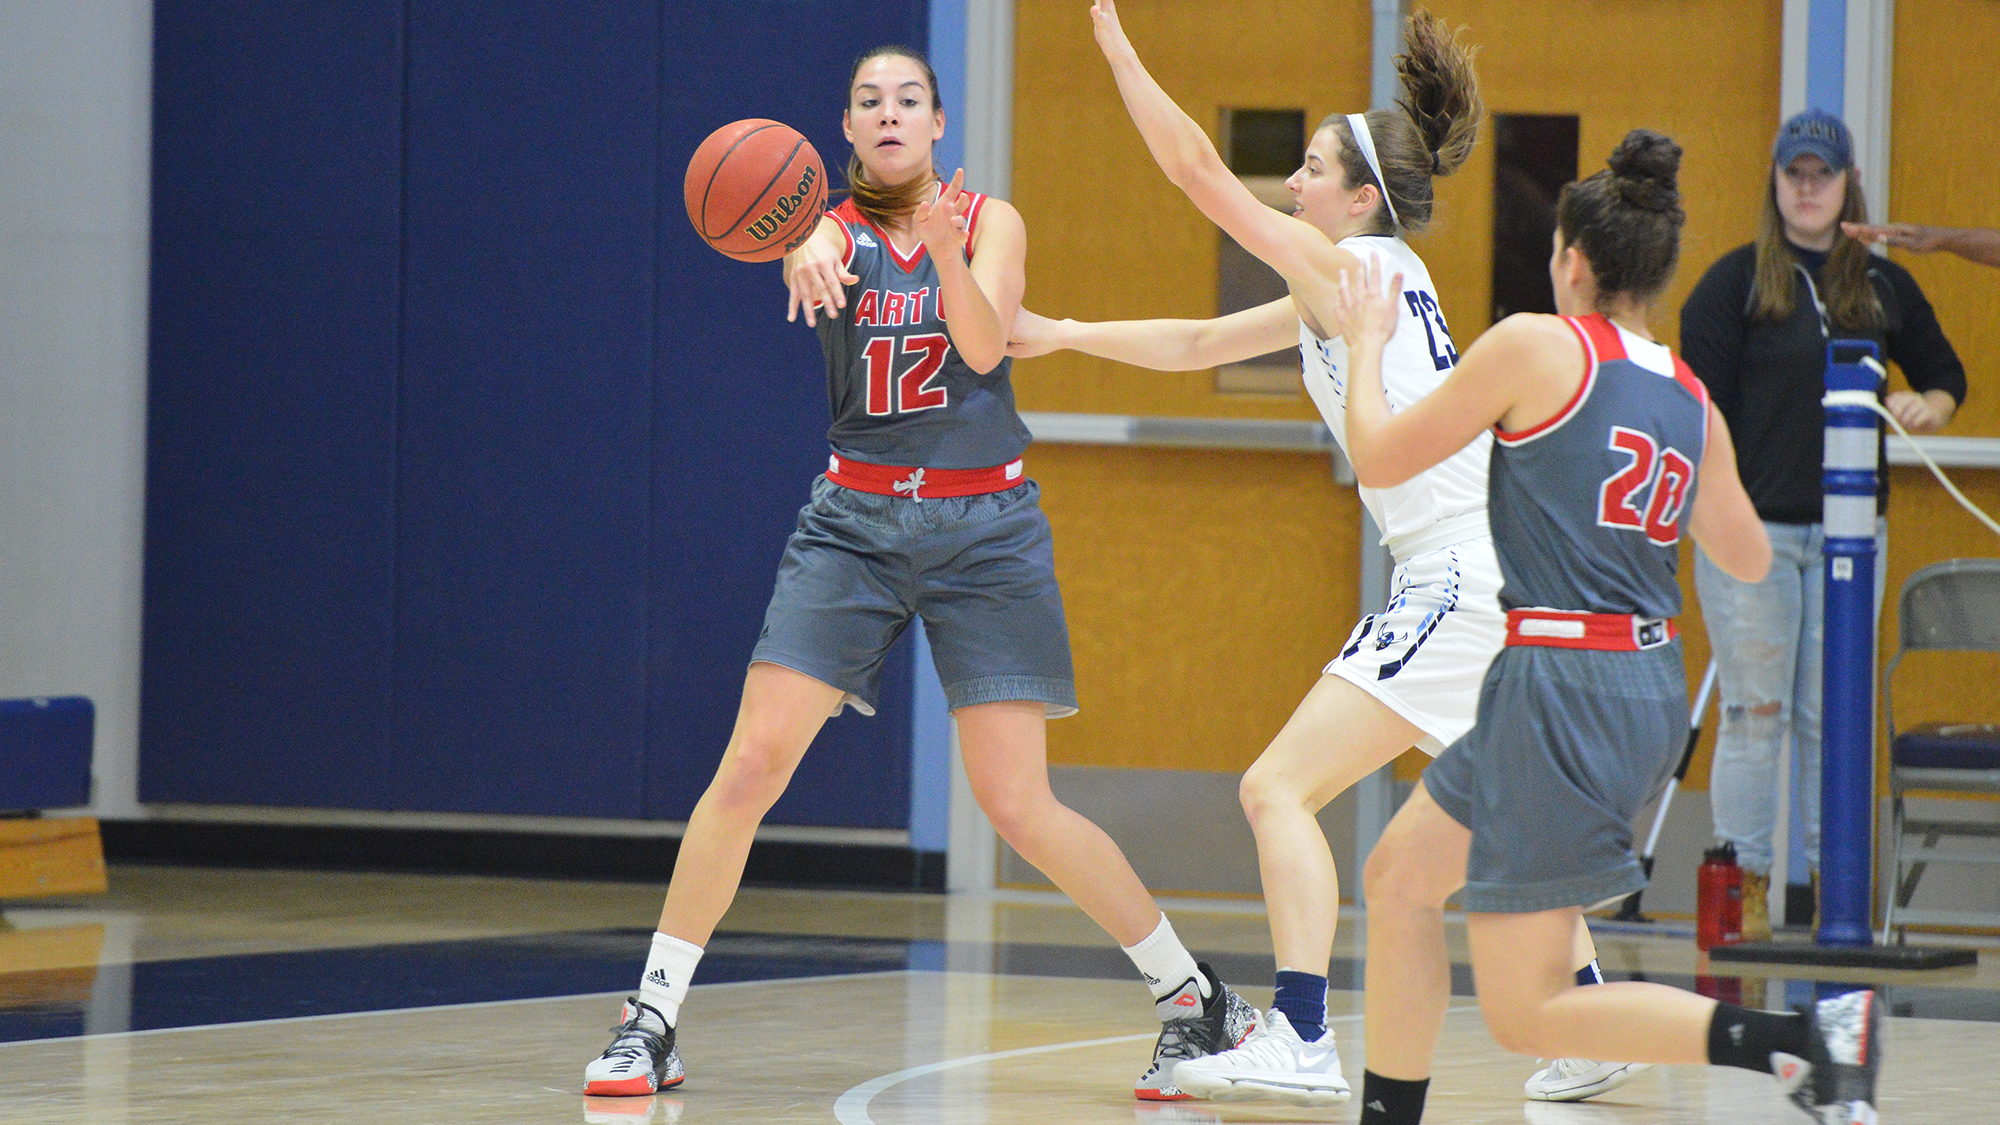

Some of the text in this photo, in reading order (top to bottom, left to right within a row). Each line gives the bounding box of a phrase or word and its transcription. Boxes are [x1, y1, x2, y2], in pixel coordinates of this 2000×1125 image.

[744, 164, 817, 242] Wilson
[855, 287, 930, 327] ART
[1403, 290, 1461, 372] 23
[861, 332, 951, 416] 12
[1597, 425, 1695, 547] 20
[646, 974, 671, 988] adidas
